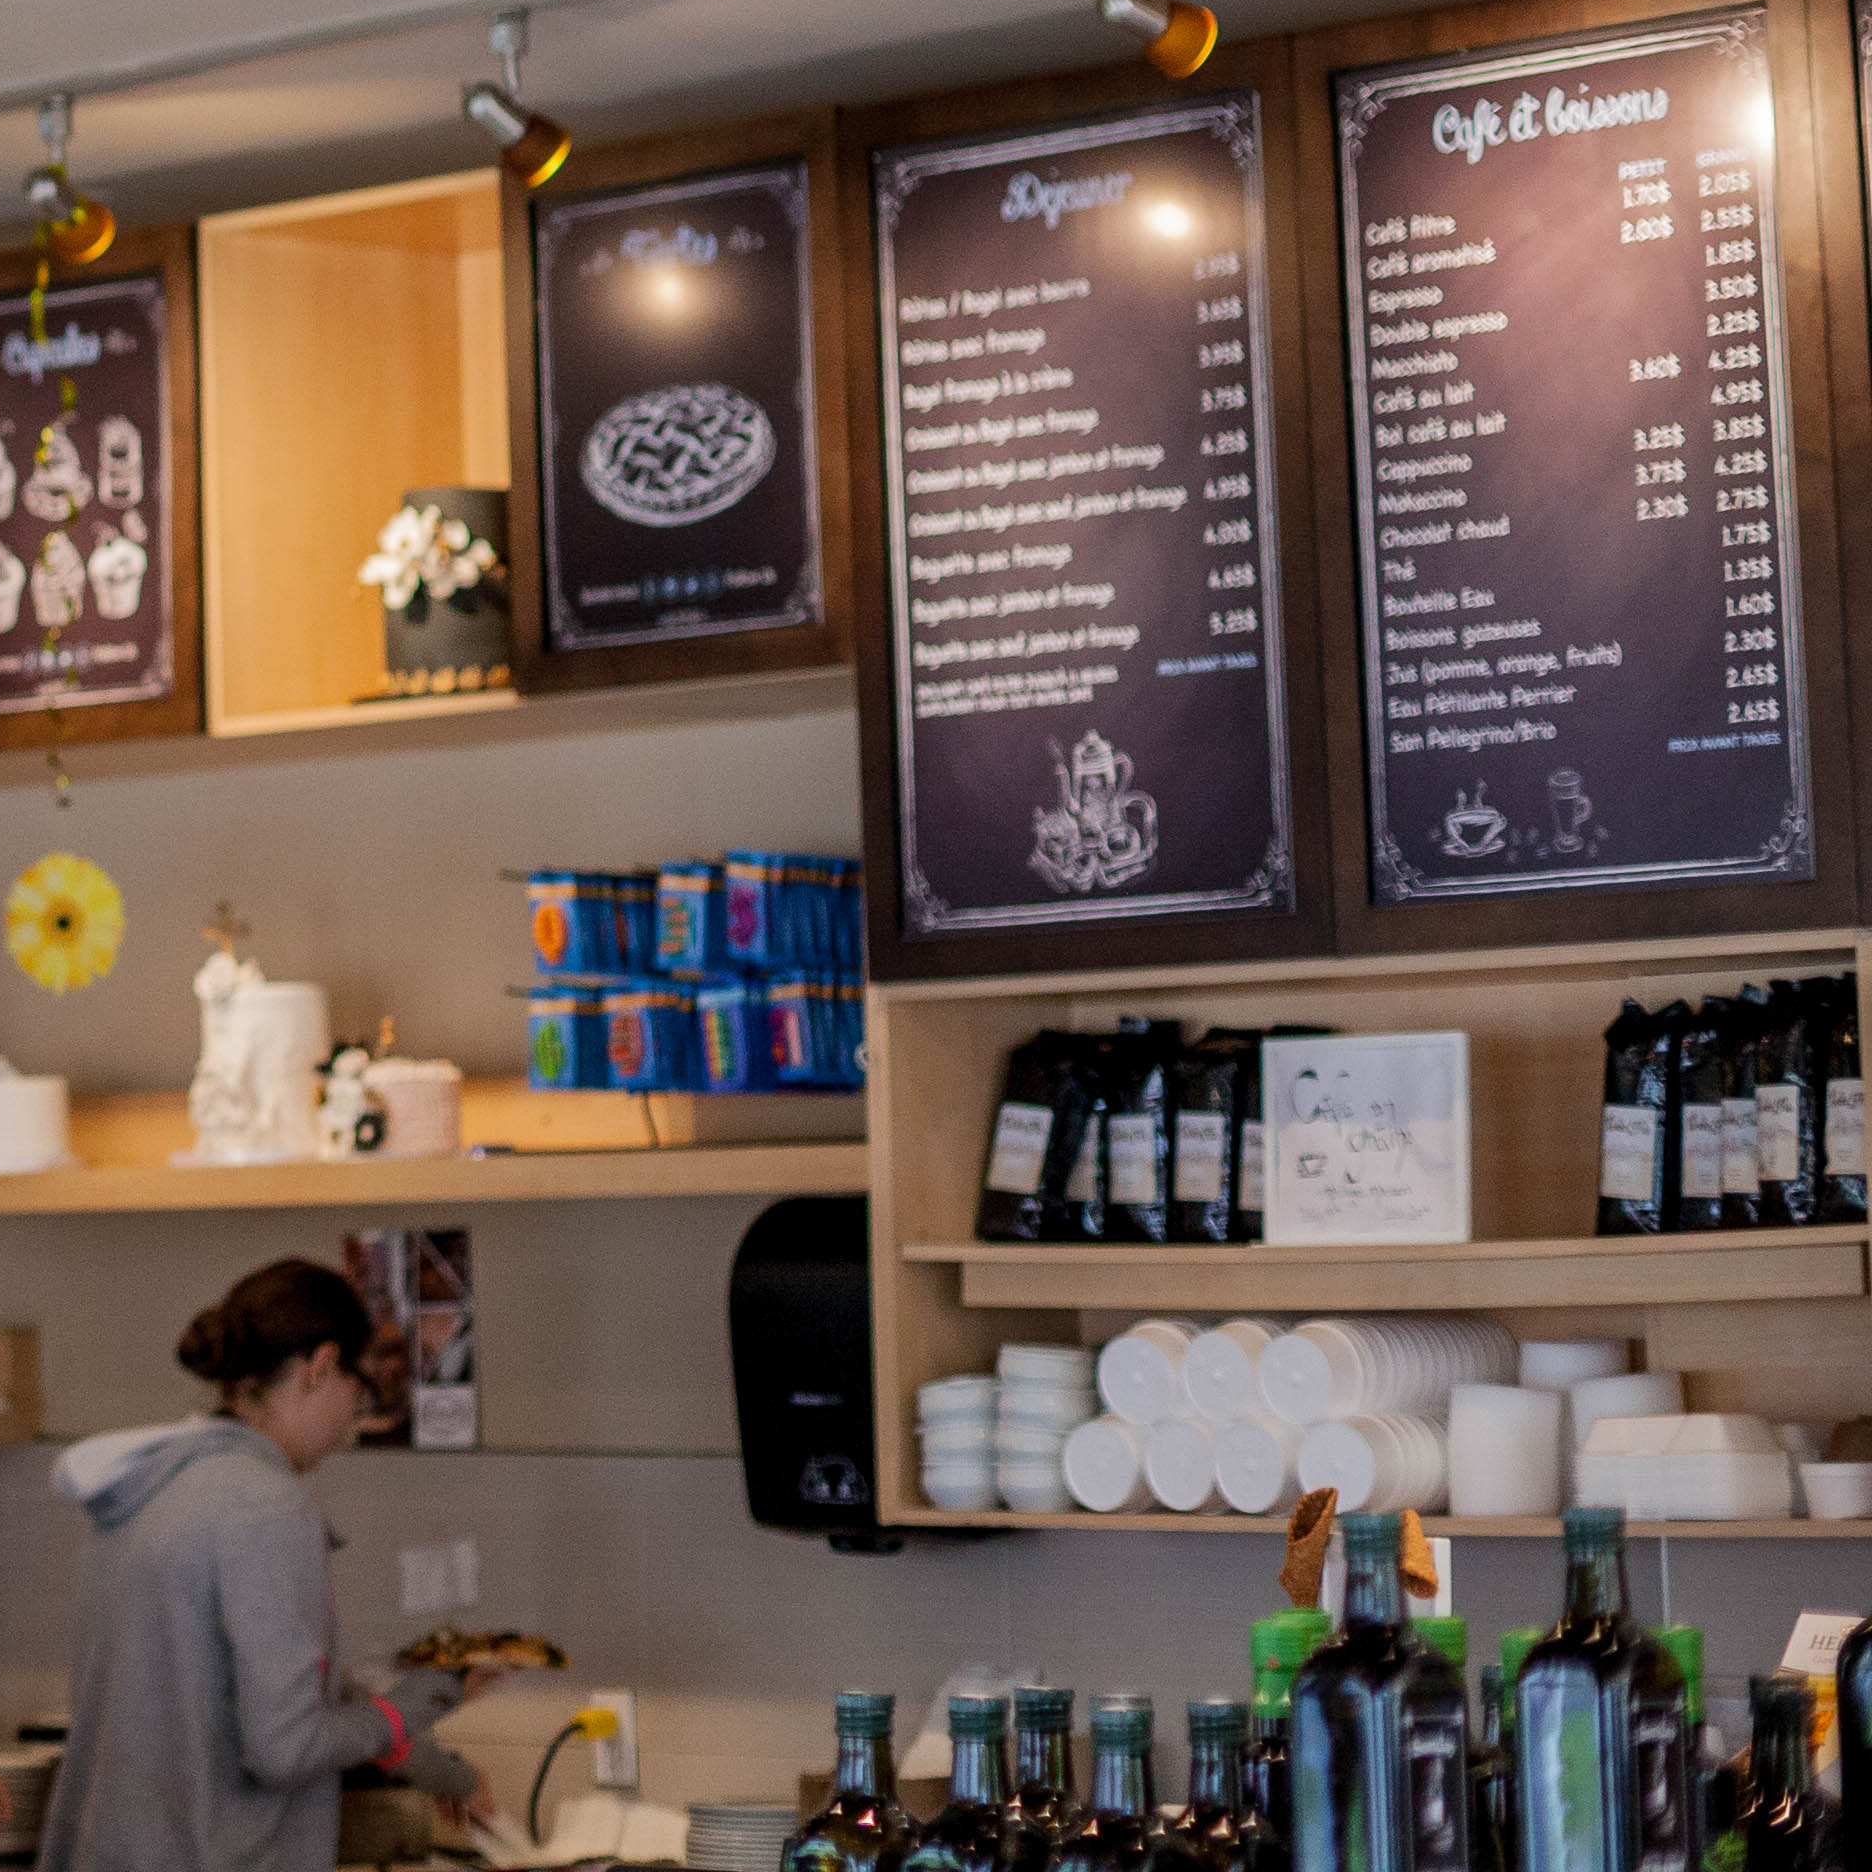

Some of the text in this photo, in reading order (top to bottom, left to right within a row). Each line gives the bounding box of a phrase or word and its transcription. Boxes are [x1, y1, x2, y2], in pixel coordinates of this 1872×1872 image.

[1432, 82, 1669, 165] Café et boissons
[1365, 215, 1408, 247] Café
[1367, 249, 1409, 280] Café
[1369, 318, 1431, 348] Double
[1373, 384, 1416, 415] Café
[1418, 388, 1443, 410] au
[1381, 555, 1417, 583] Thé
